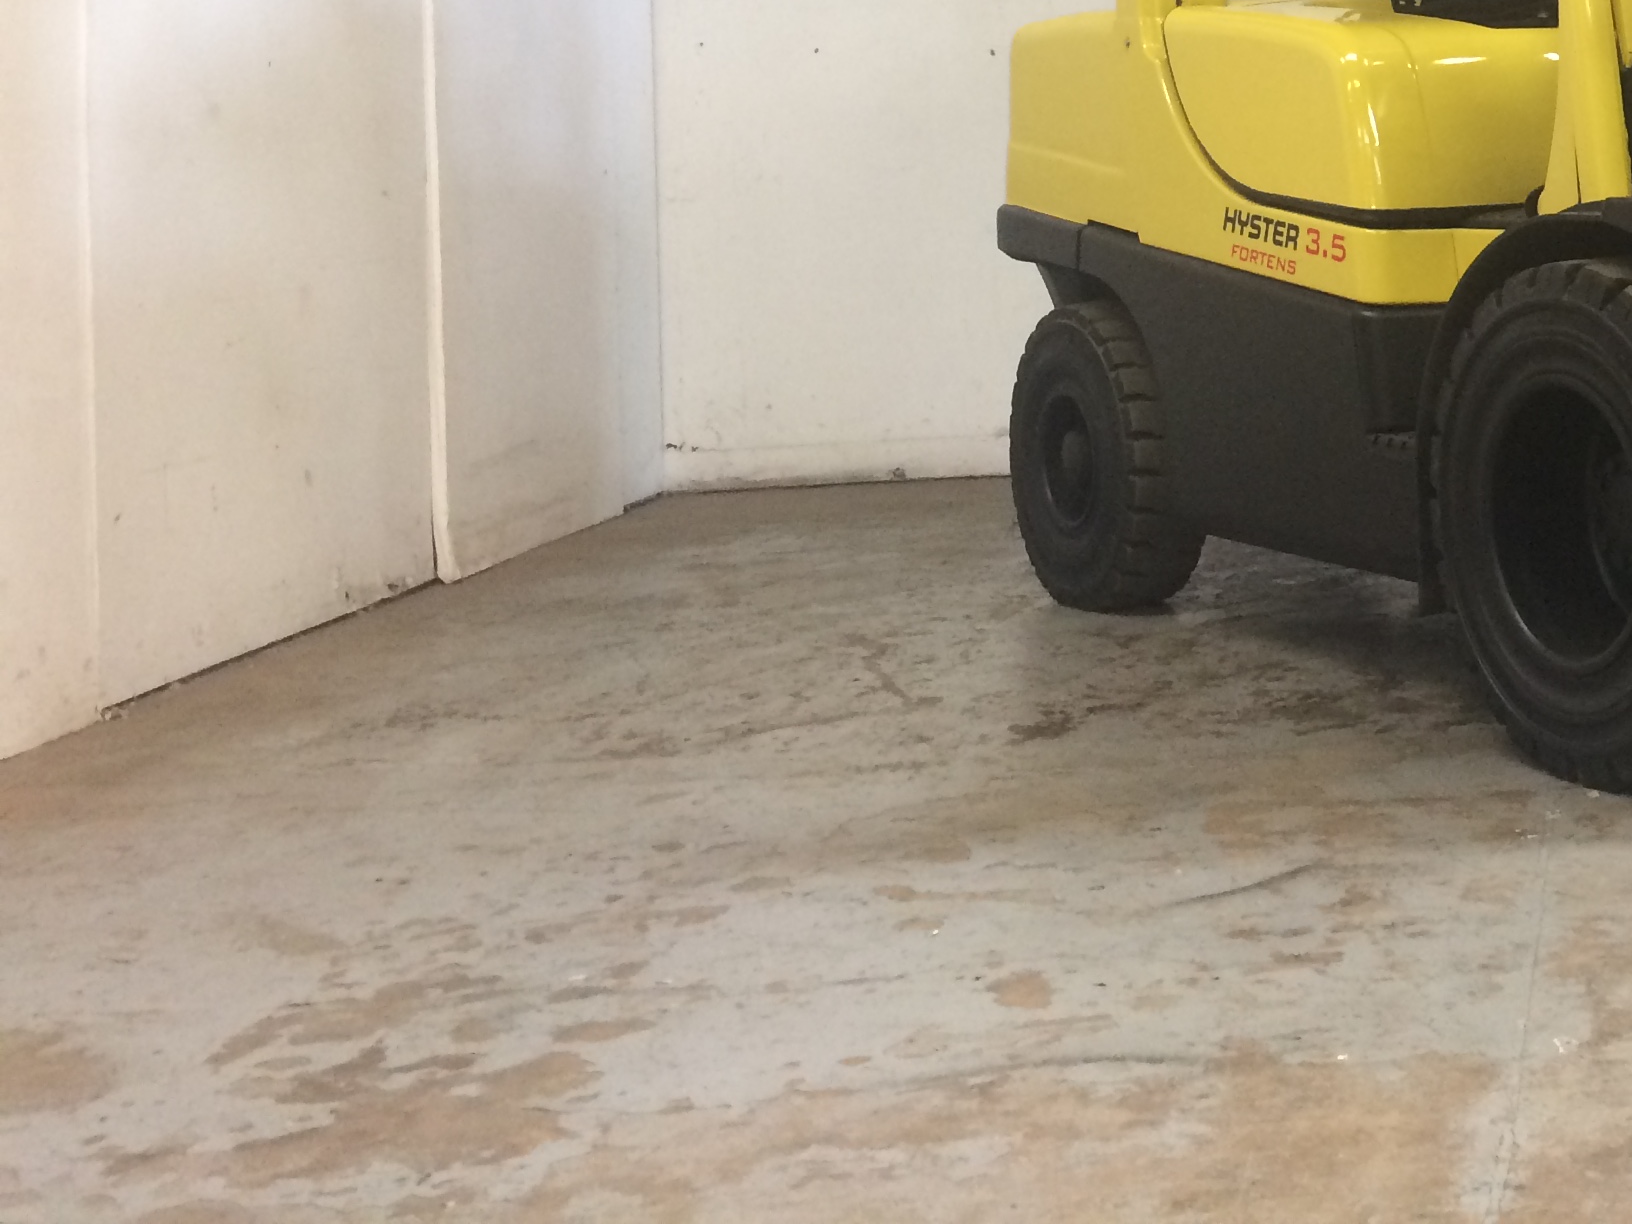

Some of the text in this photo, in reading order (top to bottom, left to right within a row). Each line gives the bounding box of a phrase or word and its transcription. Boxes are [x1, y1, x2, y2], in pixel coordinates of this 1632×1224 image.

[1222, 206, 1347, 263] HYSTER 3.5
[1231, 243, 1297, 275] FORTENS
